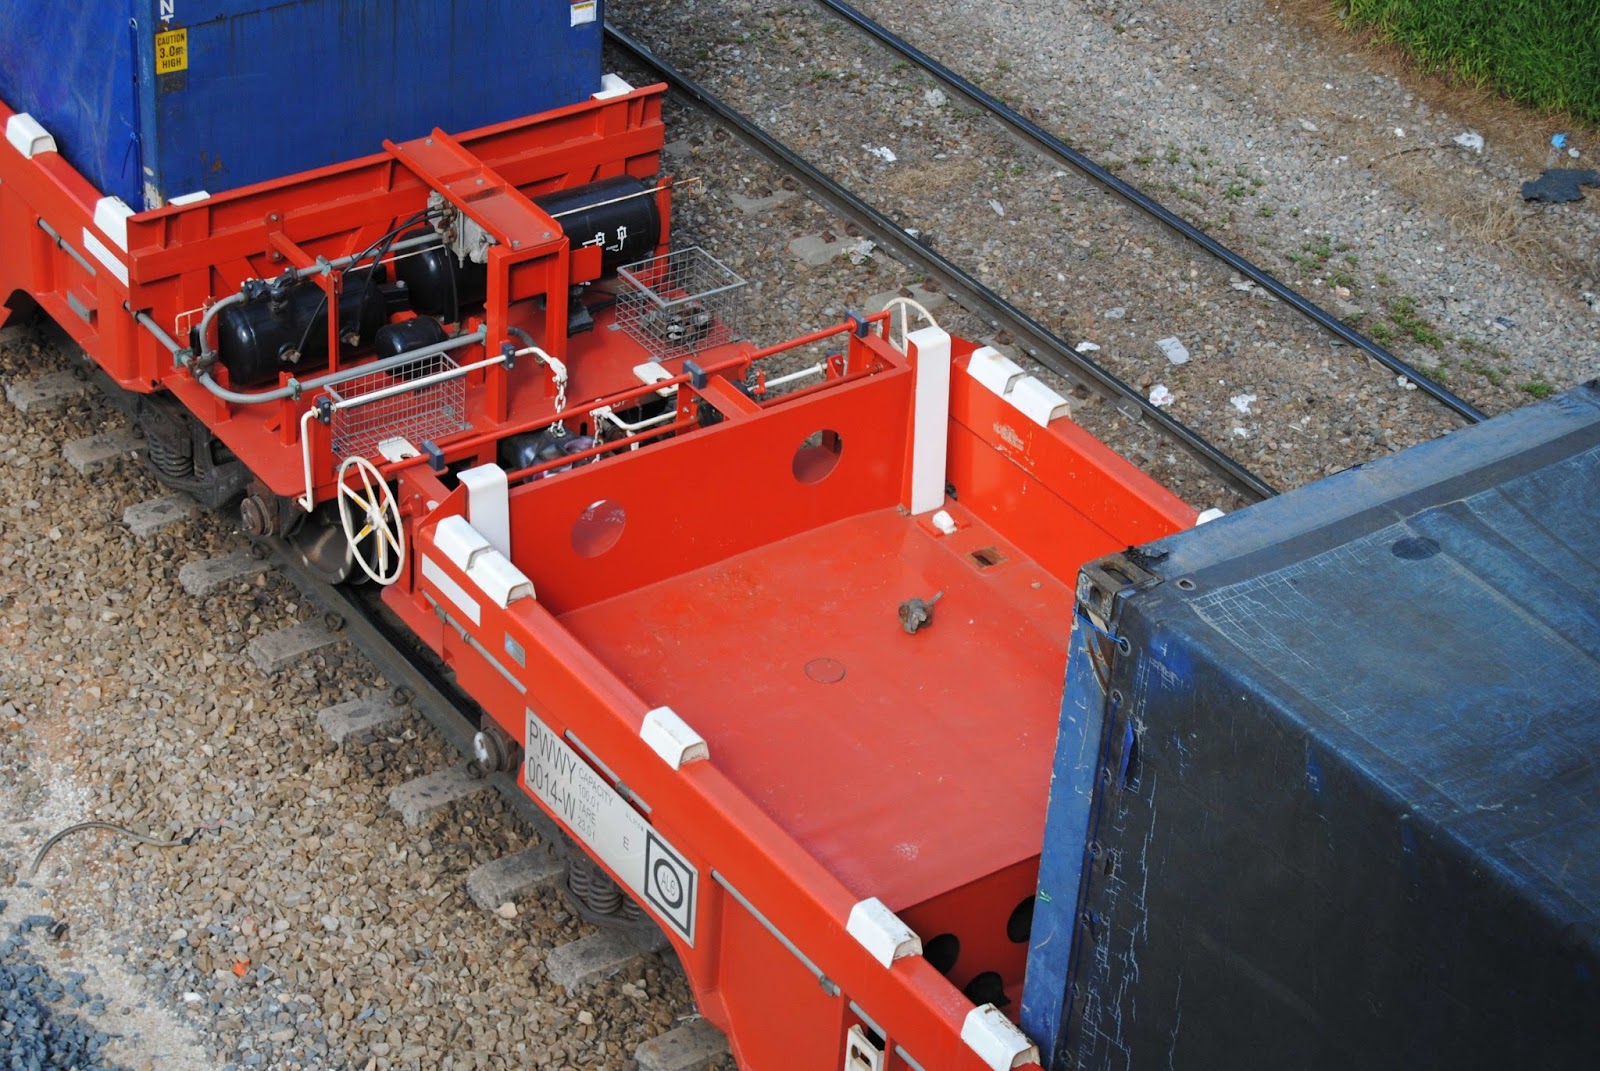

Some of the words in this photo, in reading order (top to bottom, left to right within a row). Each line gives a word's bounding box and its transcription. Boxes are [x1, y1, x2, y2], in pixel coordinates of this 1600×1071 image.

[157, 33, 185, 46] CAUTION
[162, 57, 182, 69] HIGH
[530, 719, 576, 784] PWWY
[528, 756, 576, 821] 0014-W
[579, 767, 614, 806] CAPACITY
[578, 799, 597, 826] TARE
[623, 836, 630, 851] E
